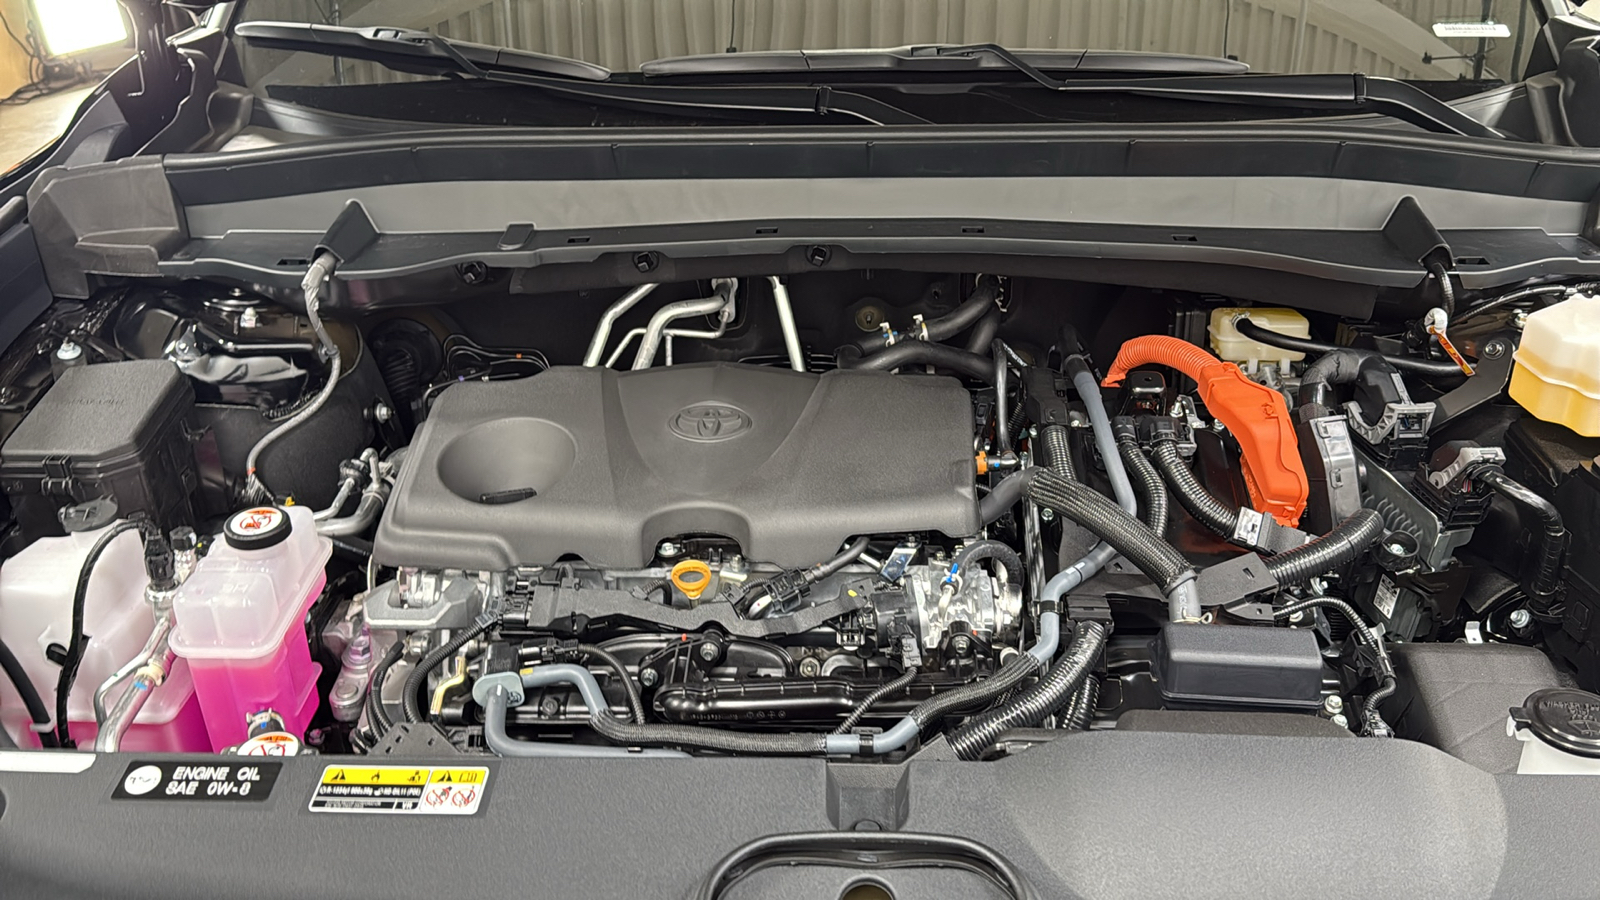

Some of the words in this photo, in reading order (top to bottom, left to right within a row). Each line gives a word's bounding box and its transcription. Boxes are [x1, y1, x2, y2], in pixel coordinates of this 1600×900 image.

[172, 766, 230, 781] ENGINE
[237, 767, 260, 781] OIL
[165, 781, 199, 795] SAE
[206, 782, 251, 796] 0W-8
